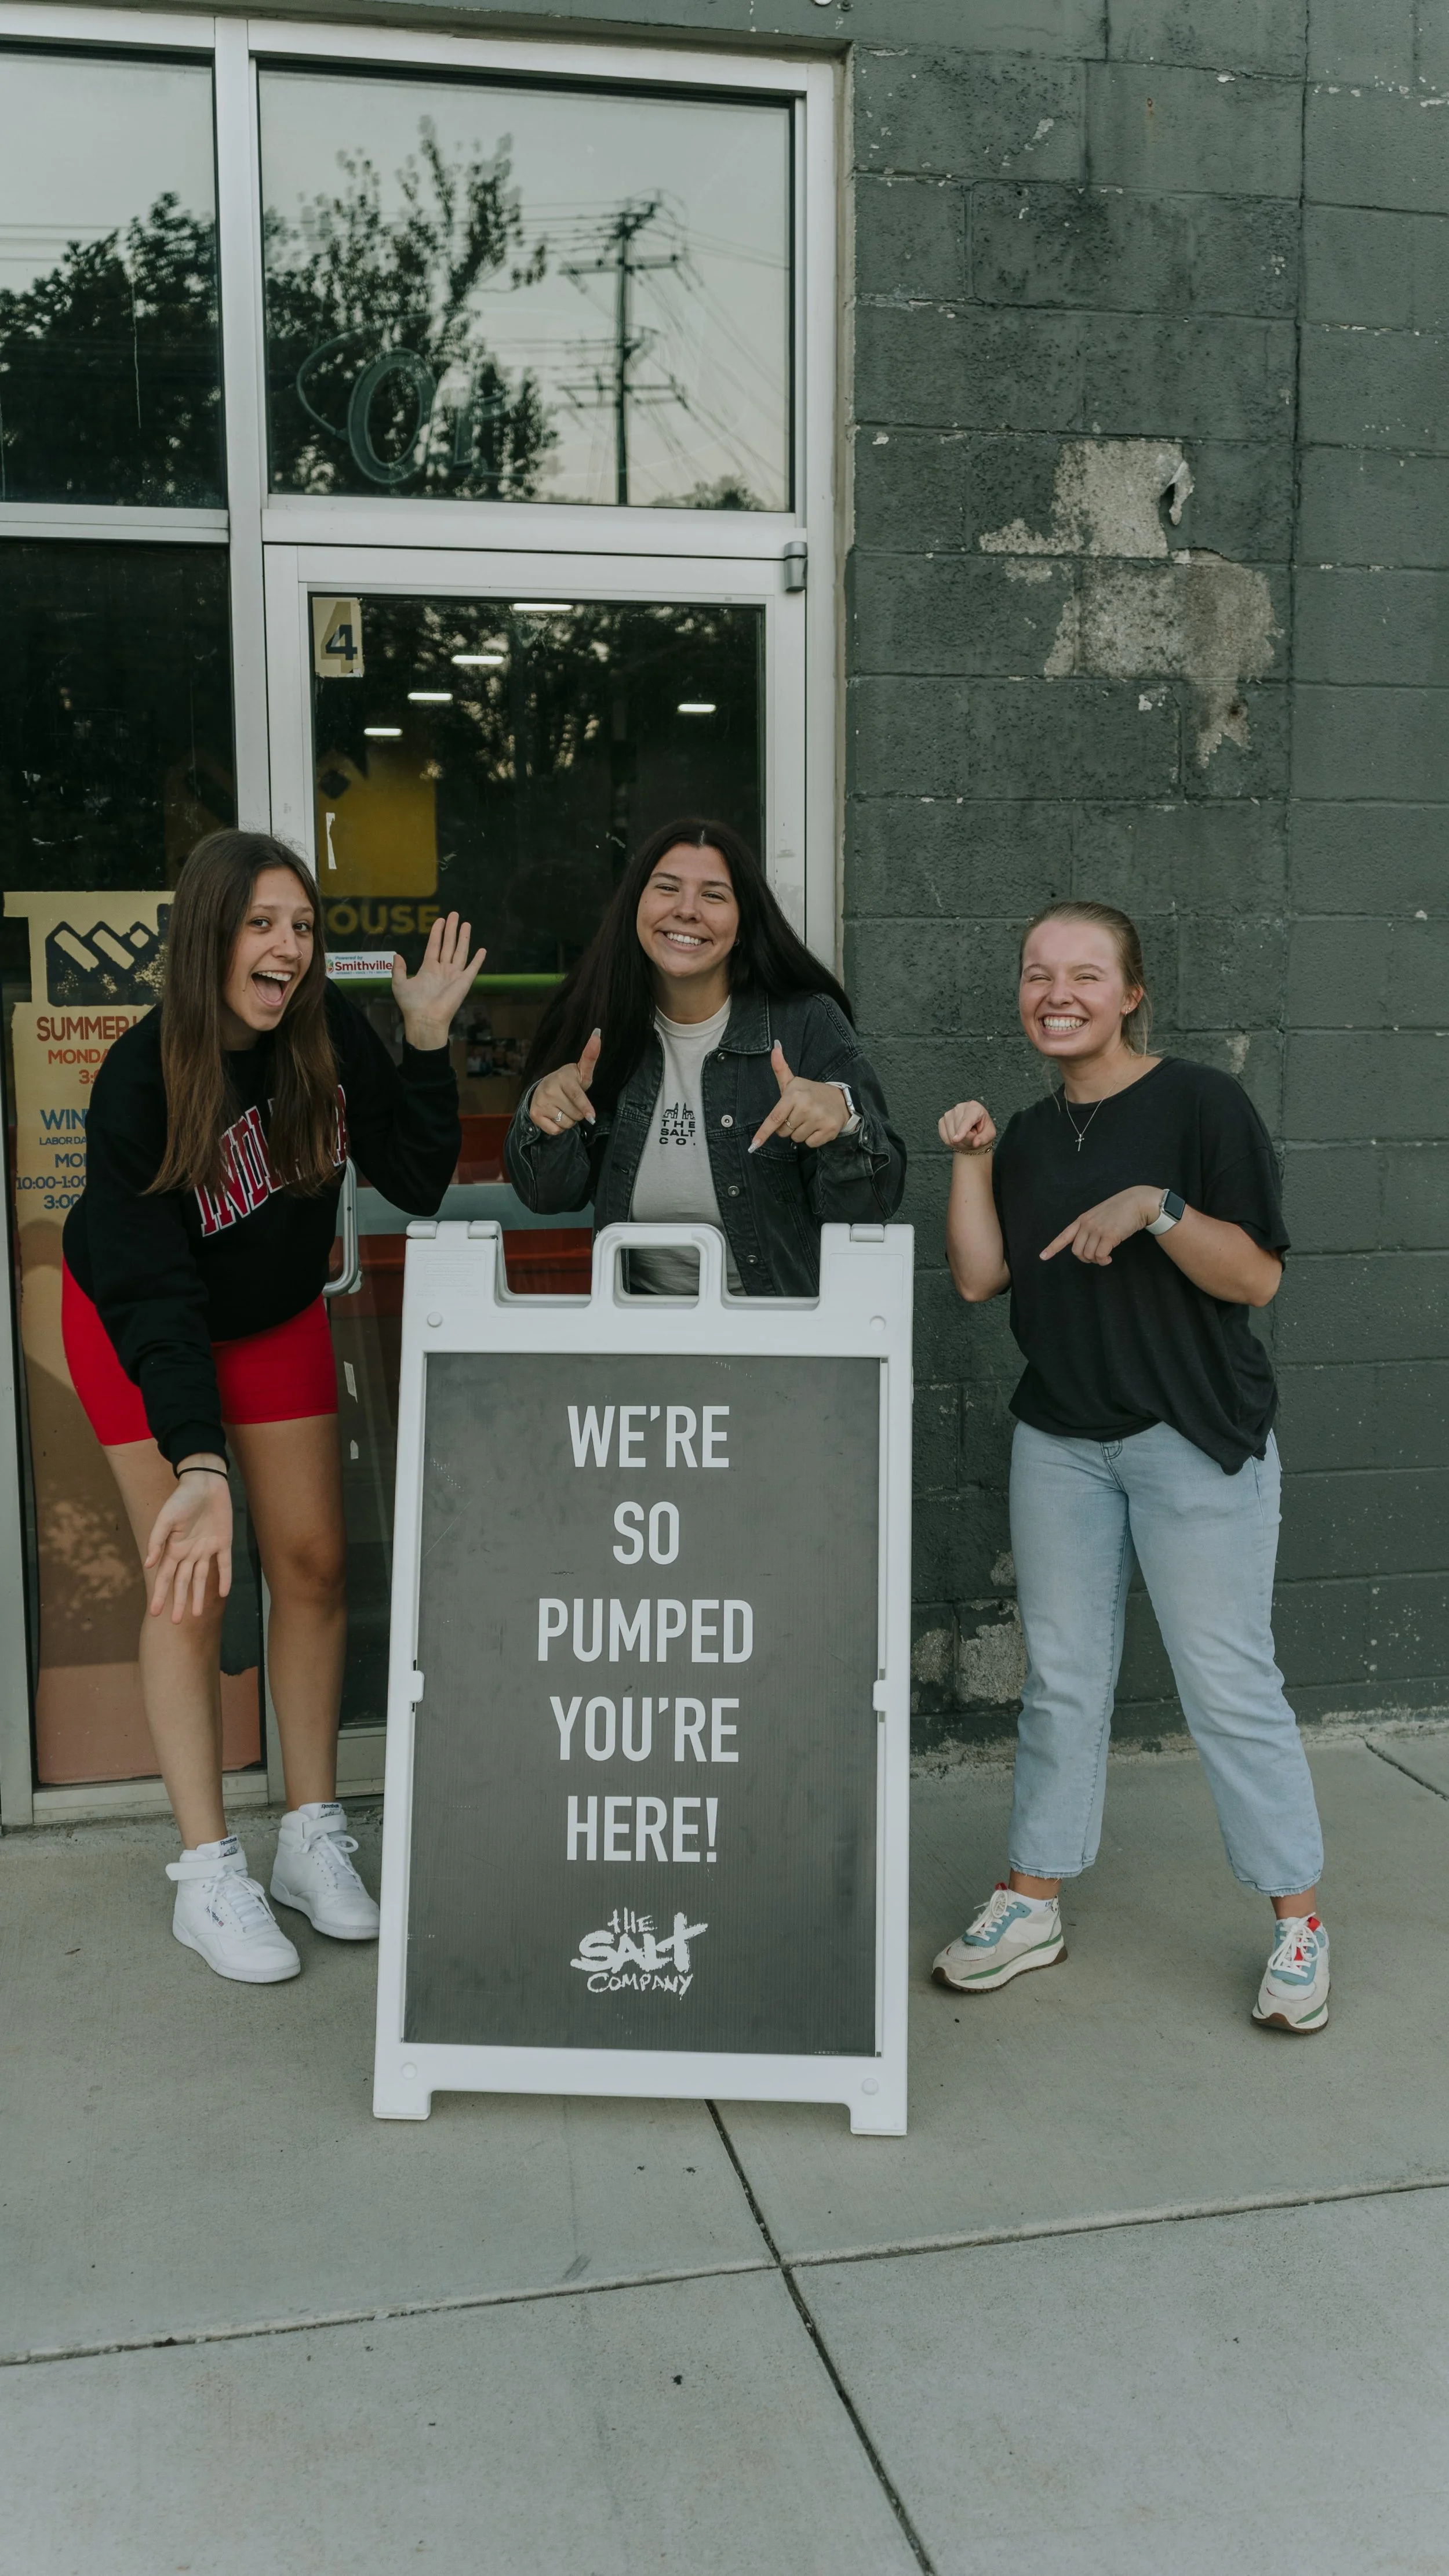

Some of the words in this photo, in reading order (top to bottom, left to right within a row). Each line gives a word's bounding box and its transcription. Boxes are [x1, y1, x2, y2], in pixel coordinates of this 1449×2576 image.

[335, 960, 392, 971] Smithville
[660, 1128, 696, 1137] SALT
[662, 1120, 696, 1128] THE
[39, 1137, 72, 1145] LABOR
[659, 1137, 696, 1146] CO.
[567, 1405, 730, 1467] WE'RE
[613, 1501, 679, 1565] SO
[538, 1598, 753, 1663] PUMPED
[549, 1696, 739, 1763] YOU'RE
[567, 1795, 718, 1863] HERE!
[587, 1972, 694, 2000] COMPANY
